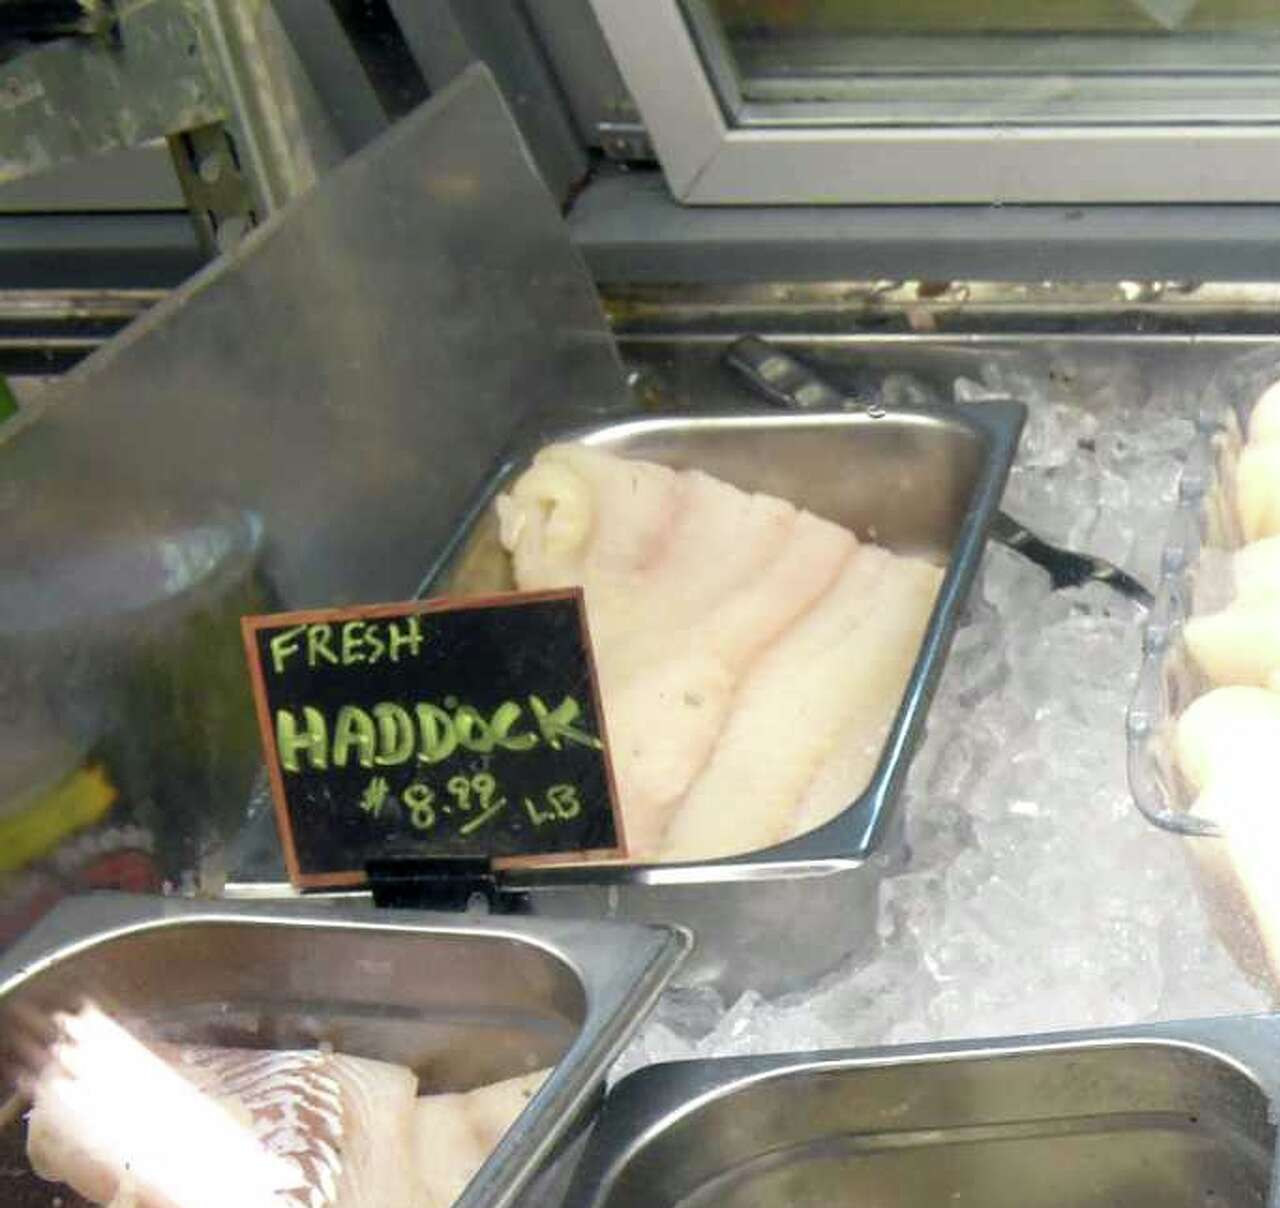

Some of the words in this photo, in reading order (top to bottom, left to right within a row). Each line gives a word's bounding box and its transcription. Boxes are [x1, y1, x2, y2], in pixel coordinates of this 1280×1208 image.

[269, 615, 424, 673] FRESH
[275, 694, 604, 772] HADDOCK
[359, 772, 506, 834] $8.99
[523, 784, 582, 826] LB
